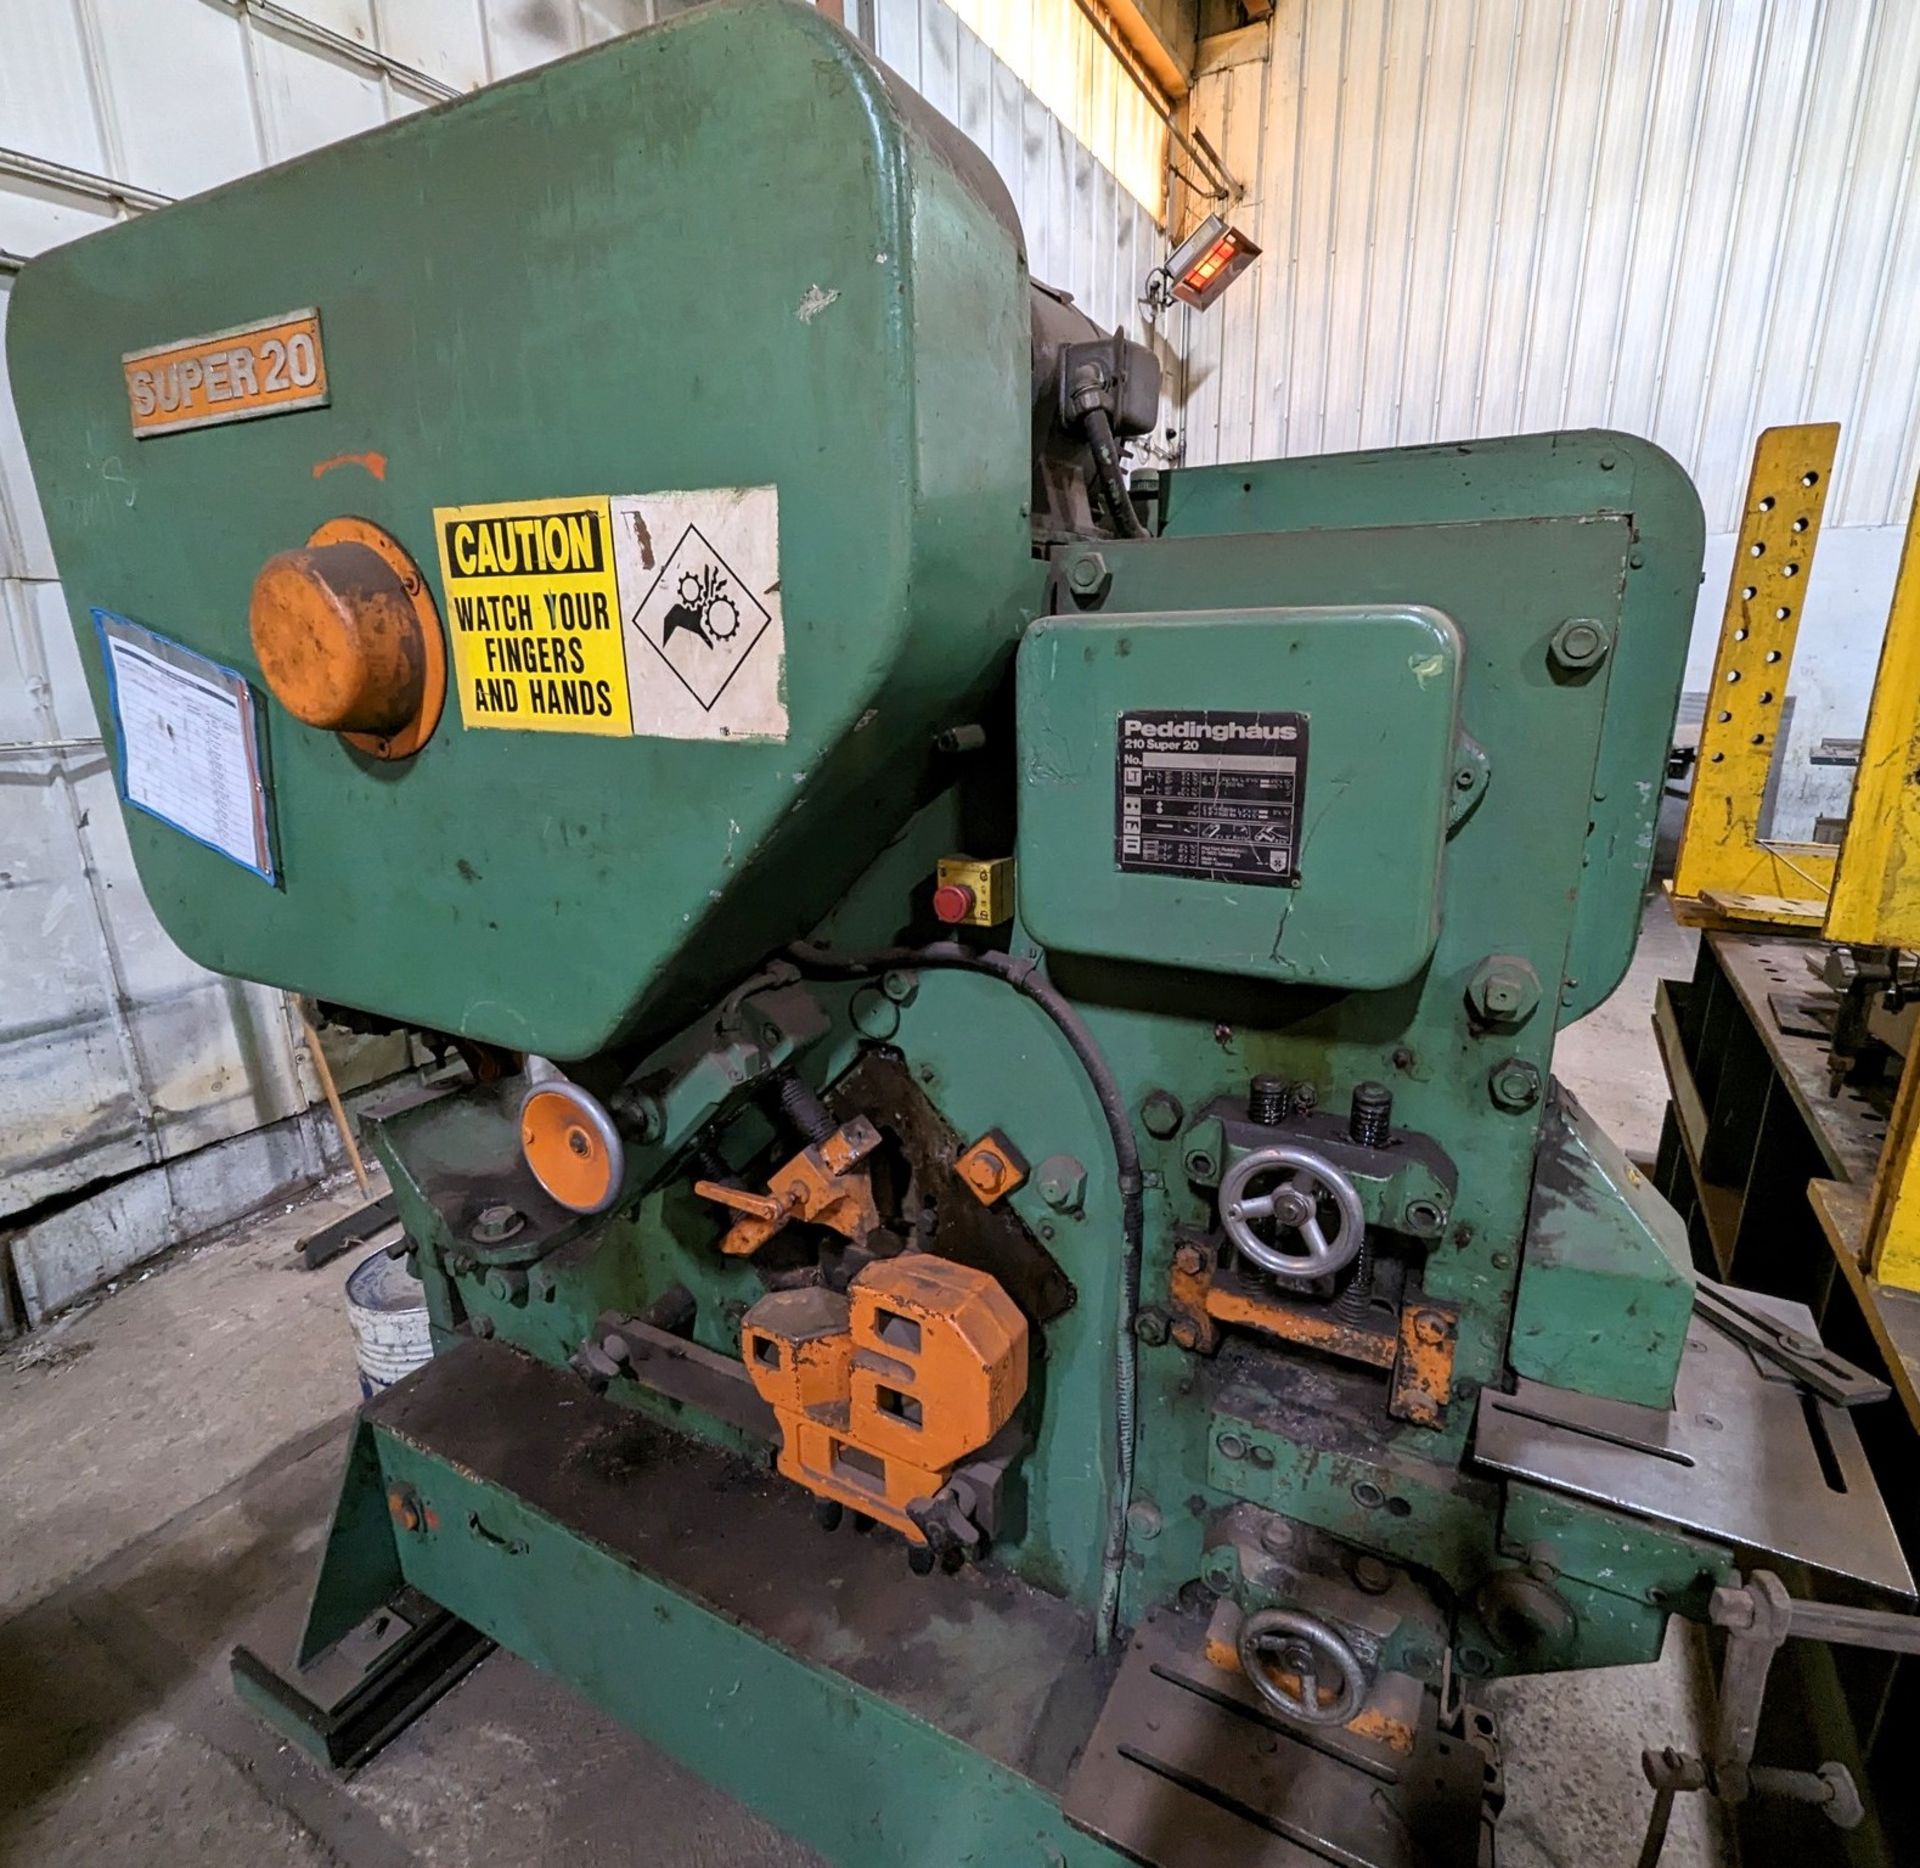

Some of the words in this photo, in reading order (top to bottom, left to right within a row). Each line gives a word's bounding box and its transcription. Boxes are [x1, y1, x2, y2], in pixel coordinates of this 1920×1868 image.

[131, 347, 259, 416] SUPER
[261, 333, 317, 393] 20
[454, 516, 597, 575] CAUTION
[455, 595, 533, 632] WATCH
[545, 591, 611, 631] YOUR
[485, 637, 585, 674] FINGERS
[475, 679, 519, 713] AND
[530, 680, 613, 717] HANDS
[1123, 719, 1298, 742] Peddinghaus
[1124, 739, 1145, 750] 210
[1147, 739, 1181, 753] Super
[1182, 741, 1200, 752] 20
[1123, 754, 1143, 766] No.
